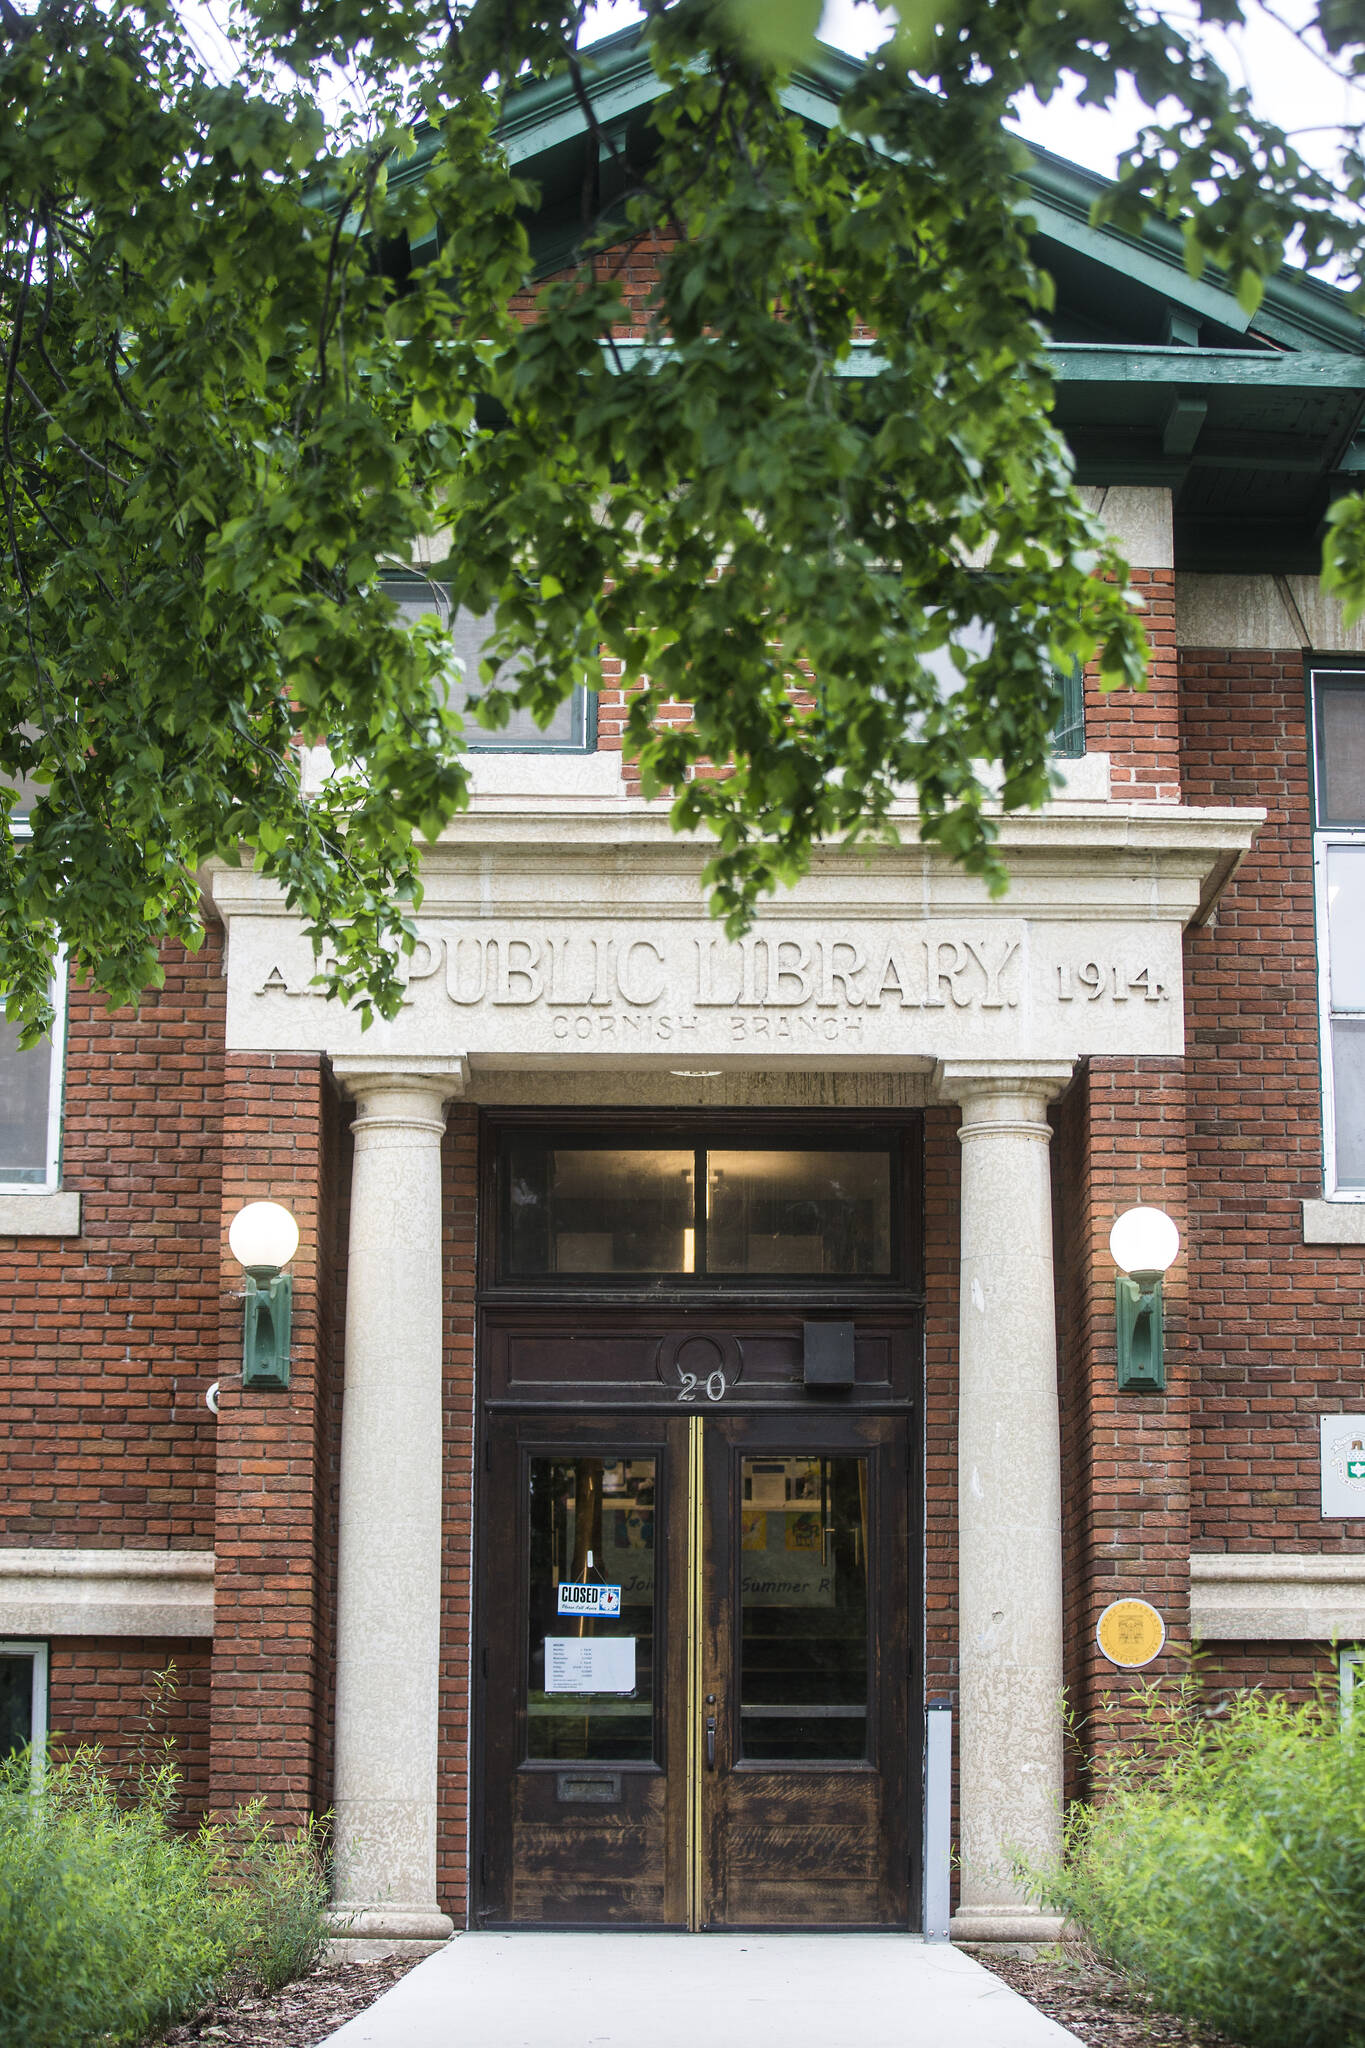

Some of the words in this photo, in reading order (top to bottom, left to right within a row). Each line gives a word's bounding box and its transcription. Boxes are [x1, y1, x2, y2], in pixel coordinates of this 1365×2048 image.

[394, 935, 666, 1006] PUBLIC
[553, 1014, 698, 1041] CORNISH
[730, 1016, 863, 1043] BRANCH
[677, 1370, 726, 1401] 20
[562, 1586, 599, 1603] CLOSED
[742, 1577, 810, 1593] Summer
